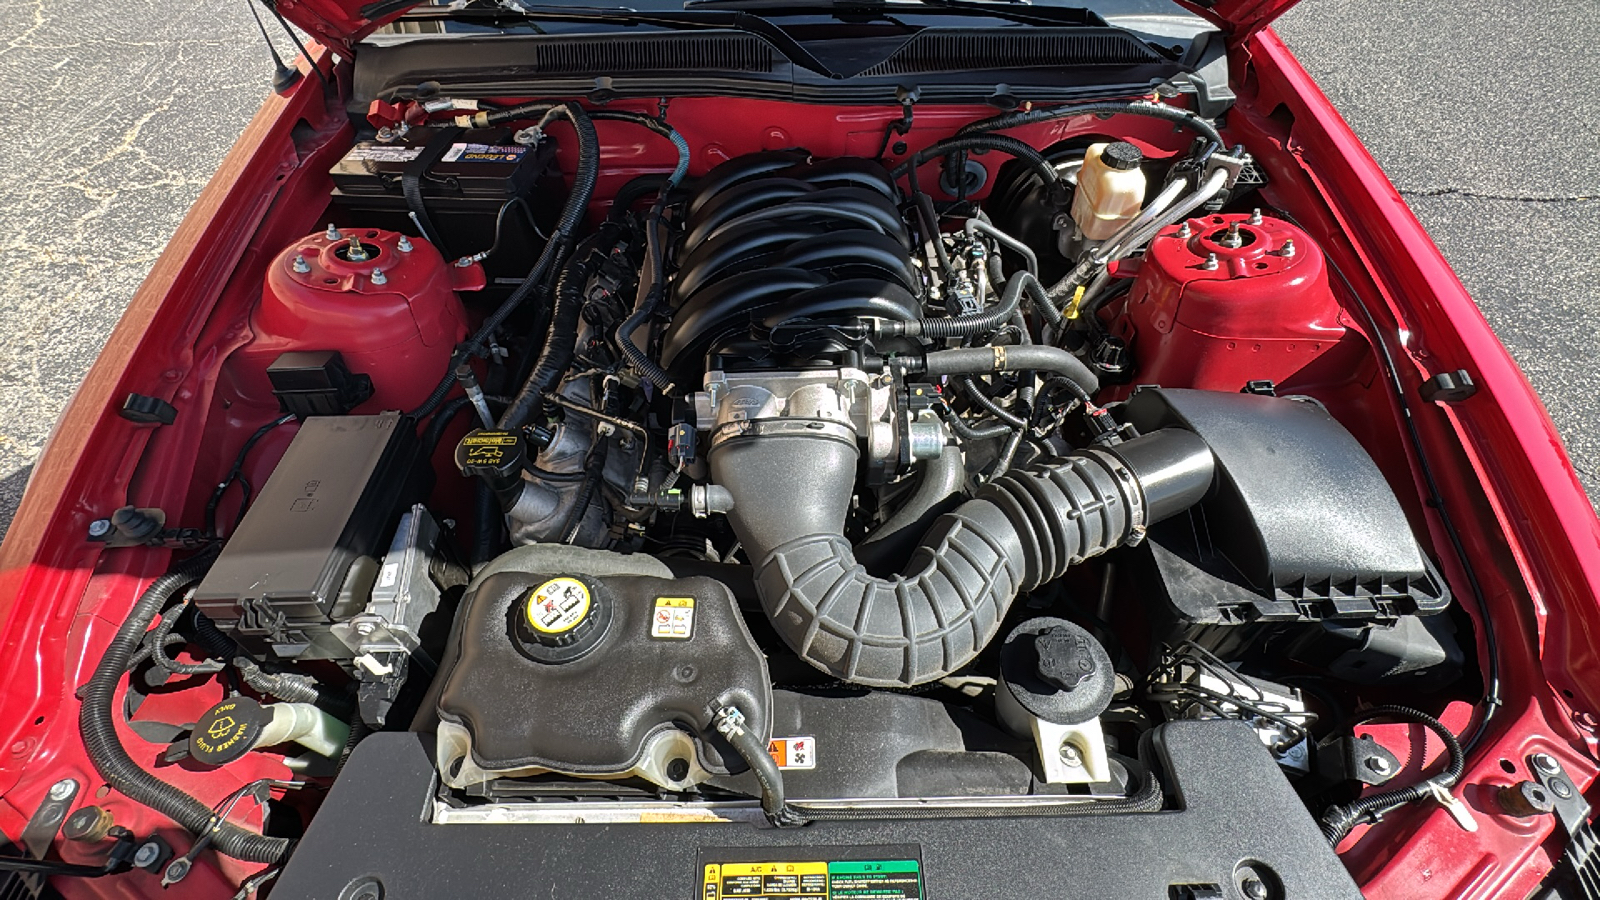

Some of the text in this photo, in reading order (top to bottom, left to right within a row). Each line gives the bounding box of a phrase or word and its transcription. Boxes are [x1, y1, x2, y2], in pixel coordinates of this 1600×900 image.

[214, 703, 236, 716] ONLY
[196, 723, 248, 753] WASHER FLUID
